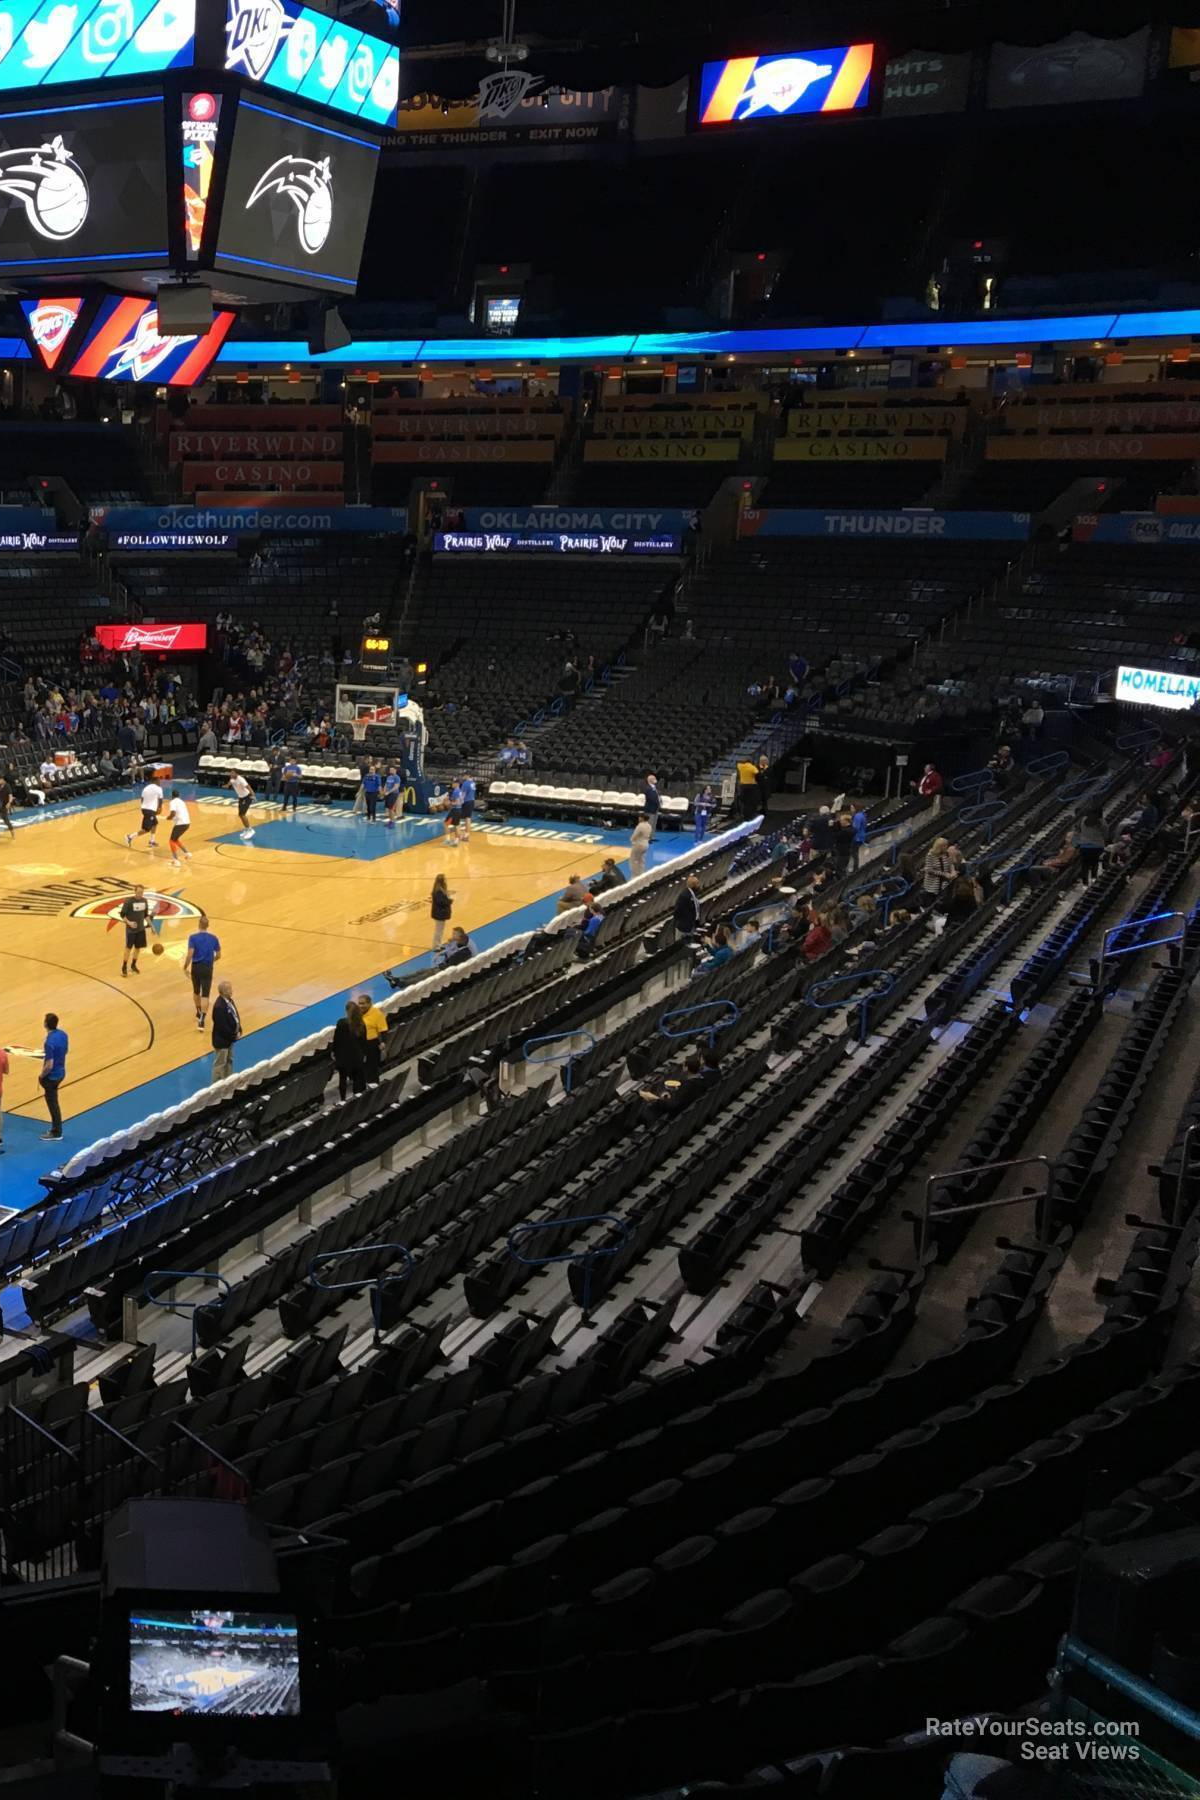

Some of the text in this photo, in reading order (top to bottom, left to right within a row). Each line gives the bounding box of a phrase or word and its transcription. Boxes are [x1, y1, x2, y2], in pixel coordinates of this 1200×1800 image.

[232, 6, 272, 52] OKC
[184, 131, 216, 141] PIZZA
[411, 134, 437, 145] THE
[441, 131, 507, 144] THUNDER
[529, 129, 563, 140] EXIT
[566, 127, 599, 138] NOW
[603, 414, 746, 432] RIVERWIND
[798, 411, 957, 430] RIVERWIND
[176, 435, 338, 453] RIVERWIND
[417, 444, 507, 460] CASINO
[616, 443, 707, 459] CASINO
[809, 441, 909, 458] CASINO
[214, 465, 312, 482] CASINO
[158, 510, 332, 530] okcthunder.com
[479, 512, 663, 530] OKLAHOMA CITY
[742, 510, 760, 520] 101
[1012, 512, 1032, 524] 101
[1076, 515, 1099, 525] 102
[824, 515, 946, 534] THUNDER
[22, 532, 48, 550] WOLF
[117, 535, 230, 546] #FOLLOWTHEWOLF
[443, 533, 483, 551] PRAIRIE
[484, 534, 513, 552] WOLF
[559, 534, 599, 551] PRAIRIE
[600, 535, 628, 553] WOLF
[127, 631, 177, 643] Budweiser
